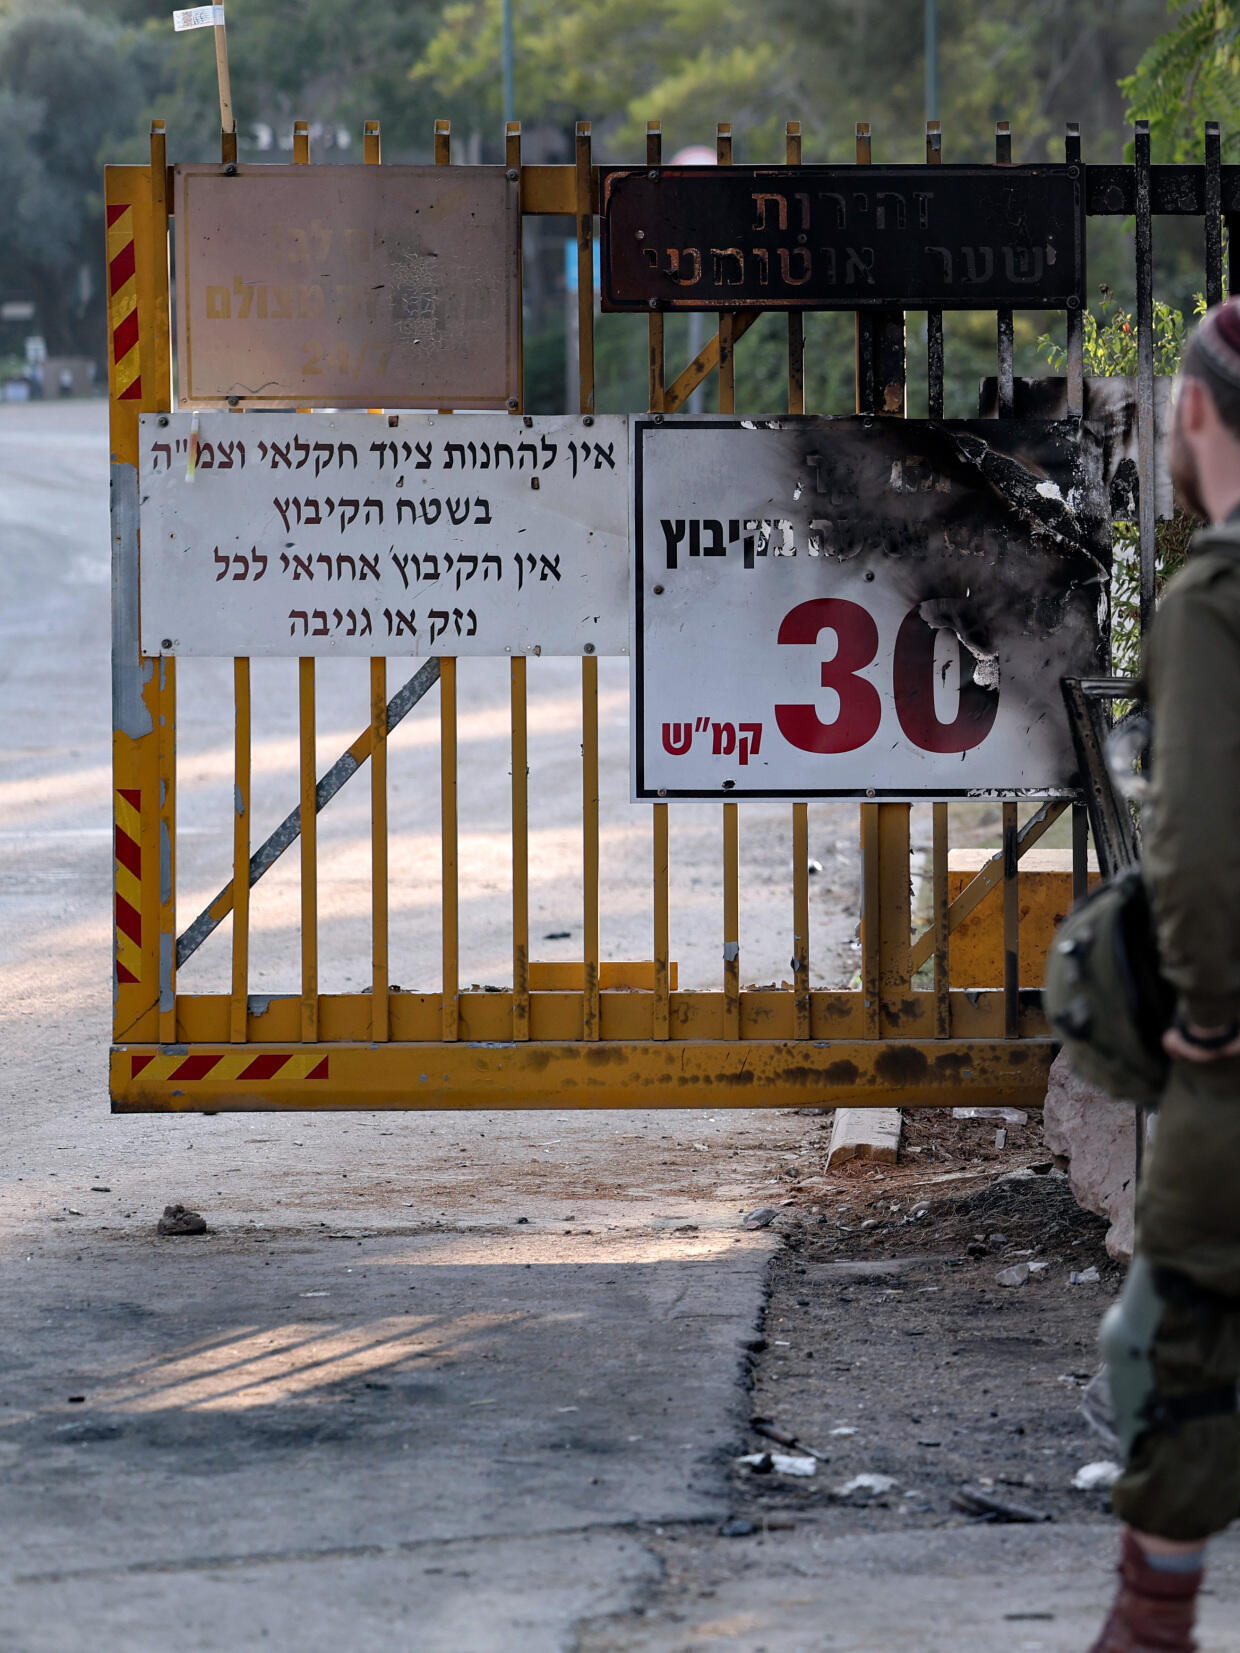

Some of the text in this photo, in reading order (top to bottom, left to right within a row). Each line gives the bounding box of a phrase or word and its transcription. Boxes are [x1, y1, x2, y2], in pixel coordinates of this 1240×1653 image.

[751, 191, 934, 231] זהירות
[641, 244, 1046, 287] שער אוטומטי
[205, 274, 326, 320] מצולם
[257, 433, 358, 479] חקלאי
[369, 440, 433, 470] ציוד
[442, 433, 558, 471] להחנות
[567, 440, 616, 480] אין
[272, 495, 493, 534] בשטח הקיבוץ
[213, 545, 562, 592] אין הקיבוץ אחראי לכל
[288, 607, 478, 646] נזק או גניבה
[774, 597, 1000, 754] 30
